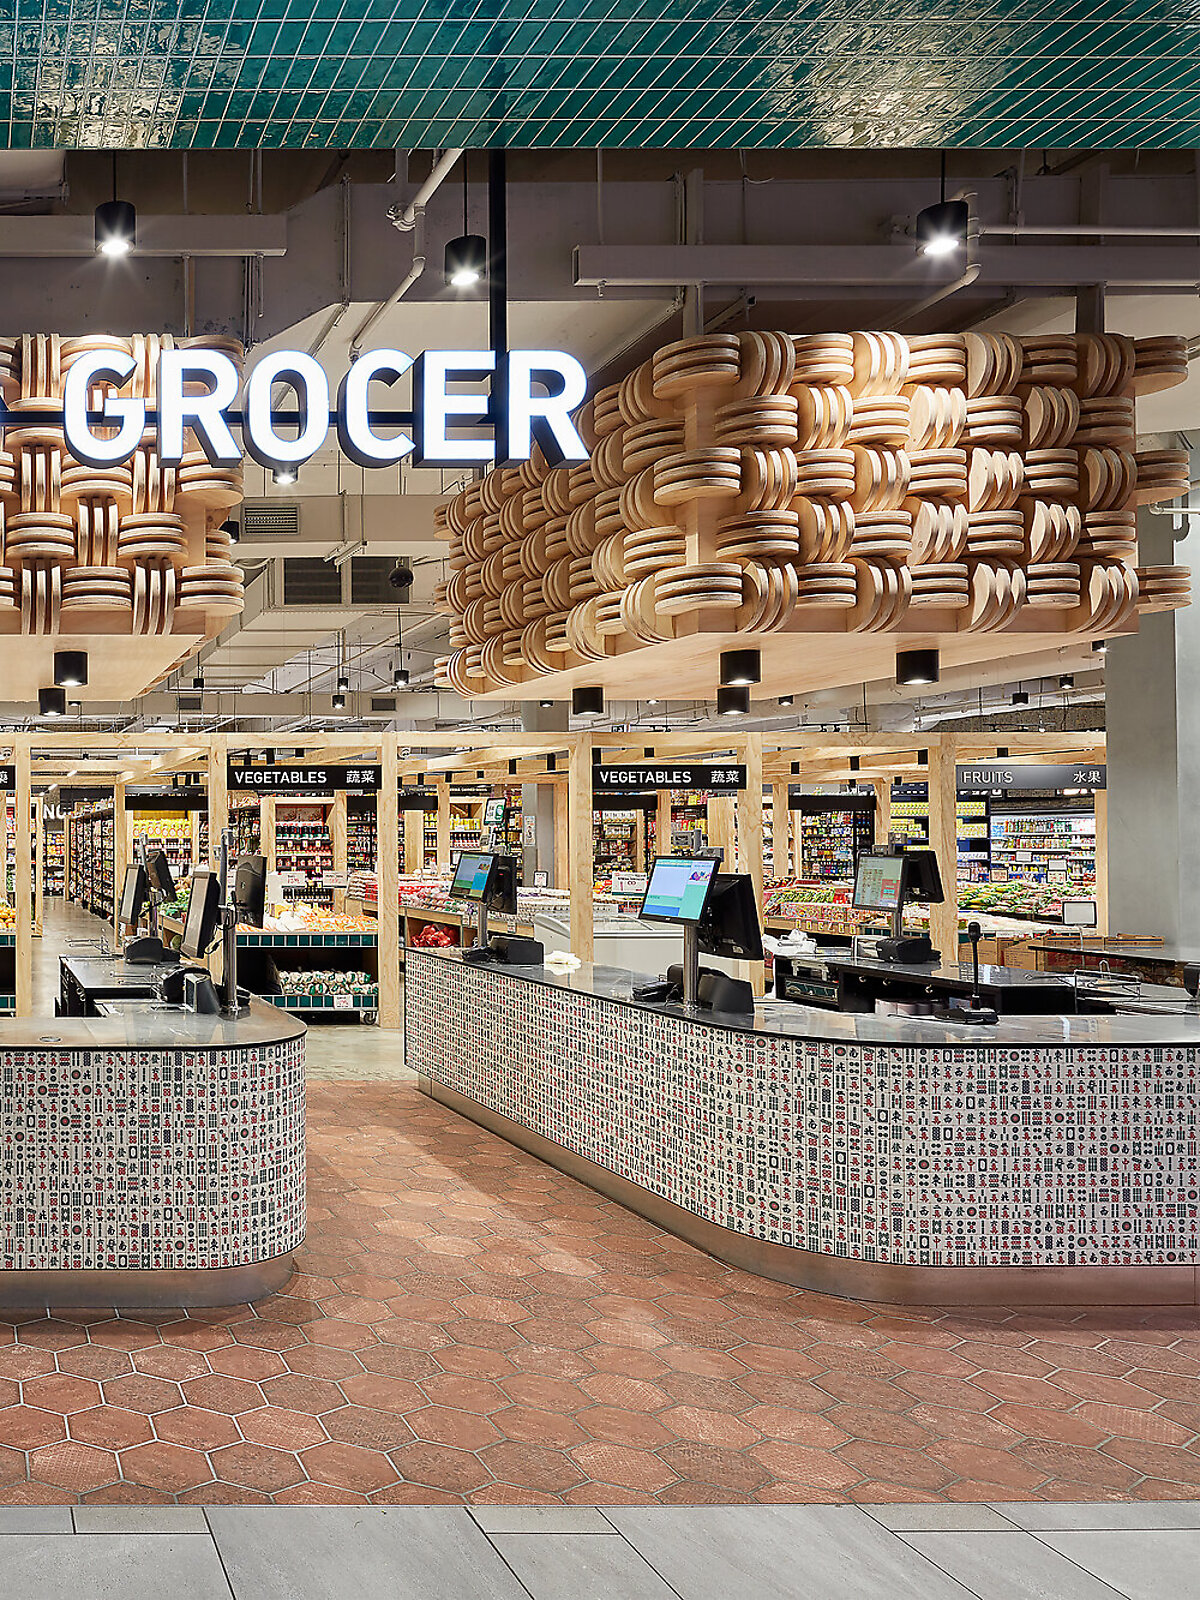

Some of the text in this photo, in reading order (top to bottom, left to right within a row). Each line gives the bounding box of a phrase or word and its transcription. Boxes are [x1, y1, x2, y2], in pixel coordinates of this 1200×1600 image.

[64, 348, 589, 461] GROCER
[234, 770, 375, 784] VEGETABLES 蔬菜
[600, 770, 740, 784] VEGETABLES 蔬菜
[963, 771, 1101, 784] FRUITS 水果
